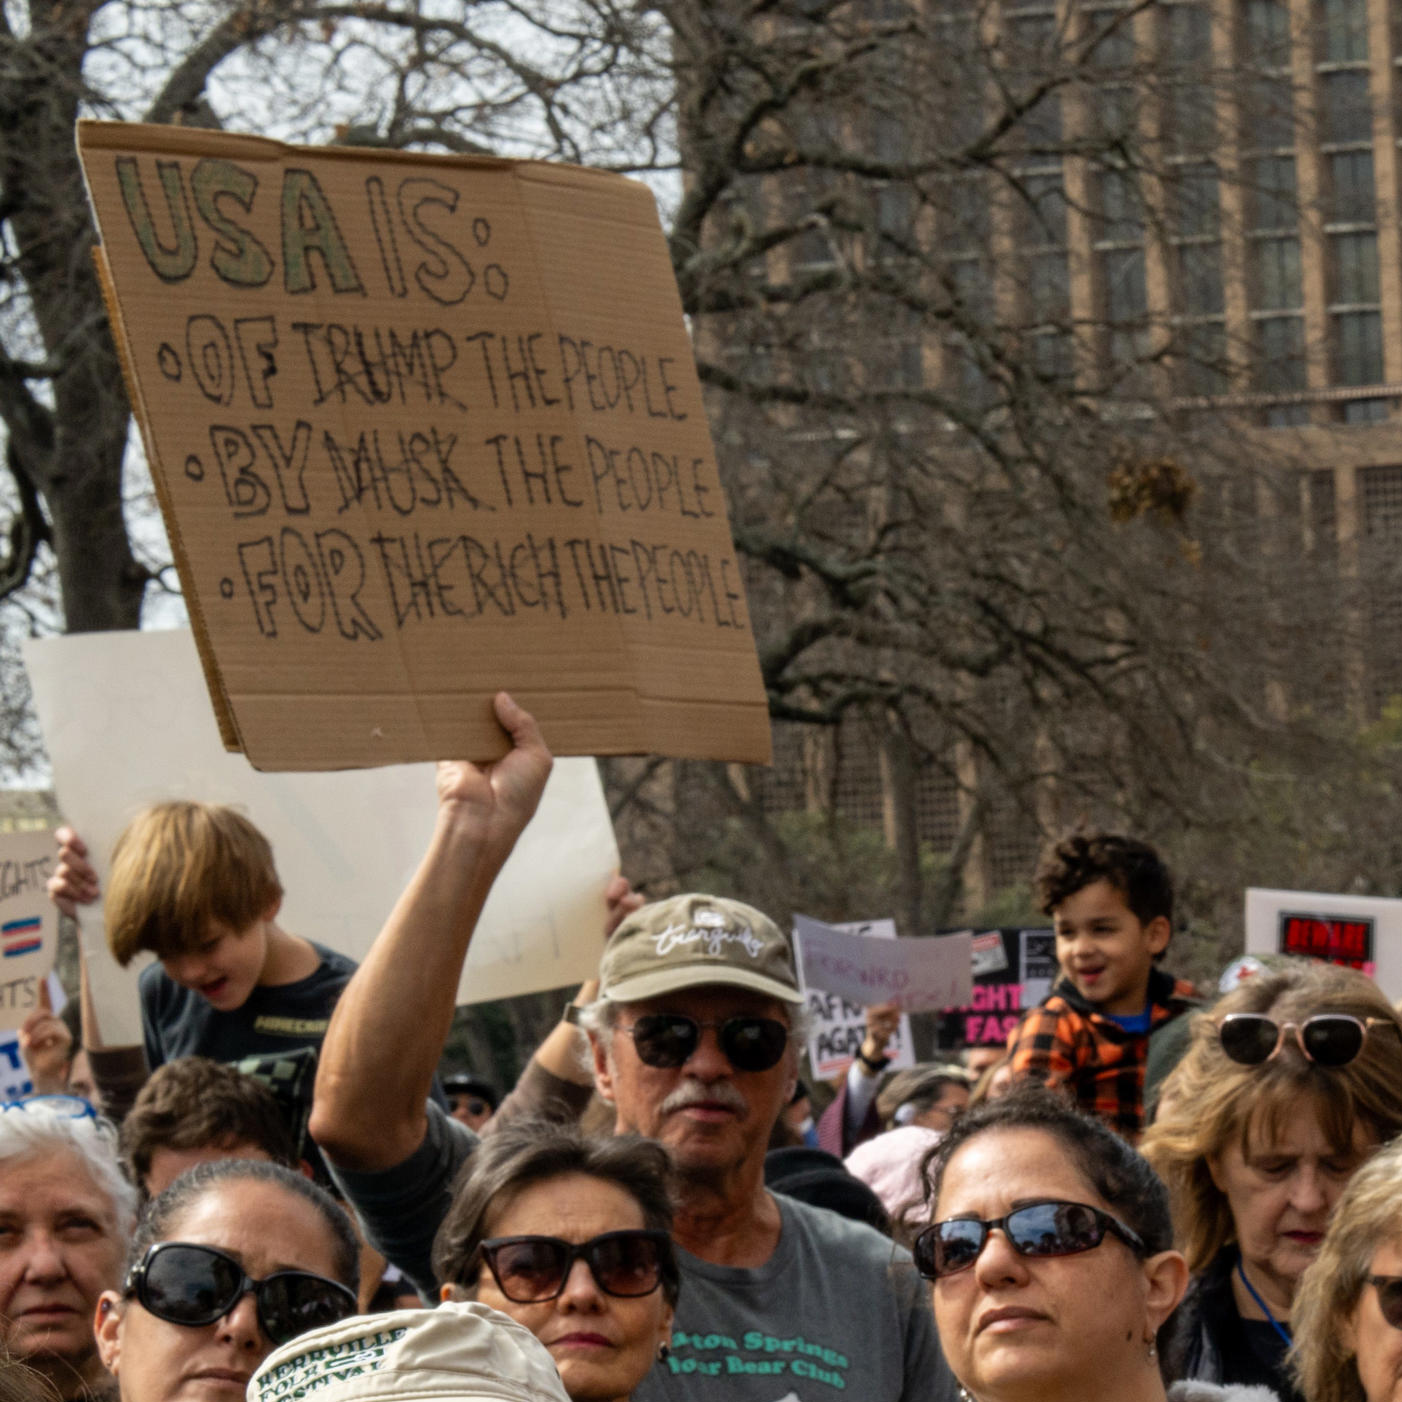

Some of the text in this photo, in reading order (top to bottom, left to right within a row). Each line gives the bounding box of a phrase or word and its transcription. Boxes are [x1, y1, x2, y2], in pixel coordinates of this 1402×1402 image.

[115, 155, 366, 297] USA
[186, 314, 278, 408] OF
[466, 330, 560, 412] THE
[557, 332, 688, 421] PEOPLE
[209, 421, 312, 518] BY
[485, 433, 586, 512] THE
[583, 433, 715, 518] PEOPLE
[238, 526, 383, 641] FOR
[564, 537, 635, 612] THE
[630, 539, 746, 631] PEOPLE
[725, 1355, 787, 1375] Bear
[790, 1359, 846, 1389] Club
[743, 1331, 849, 1368] Springs
